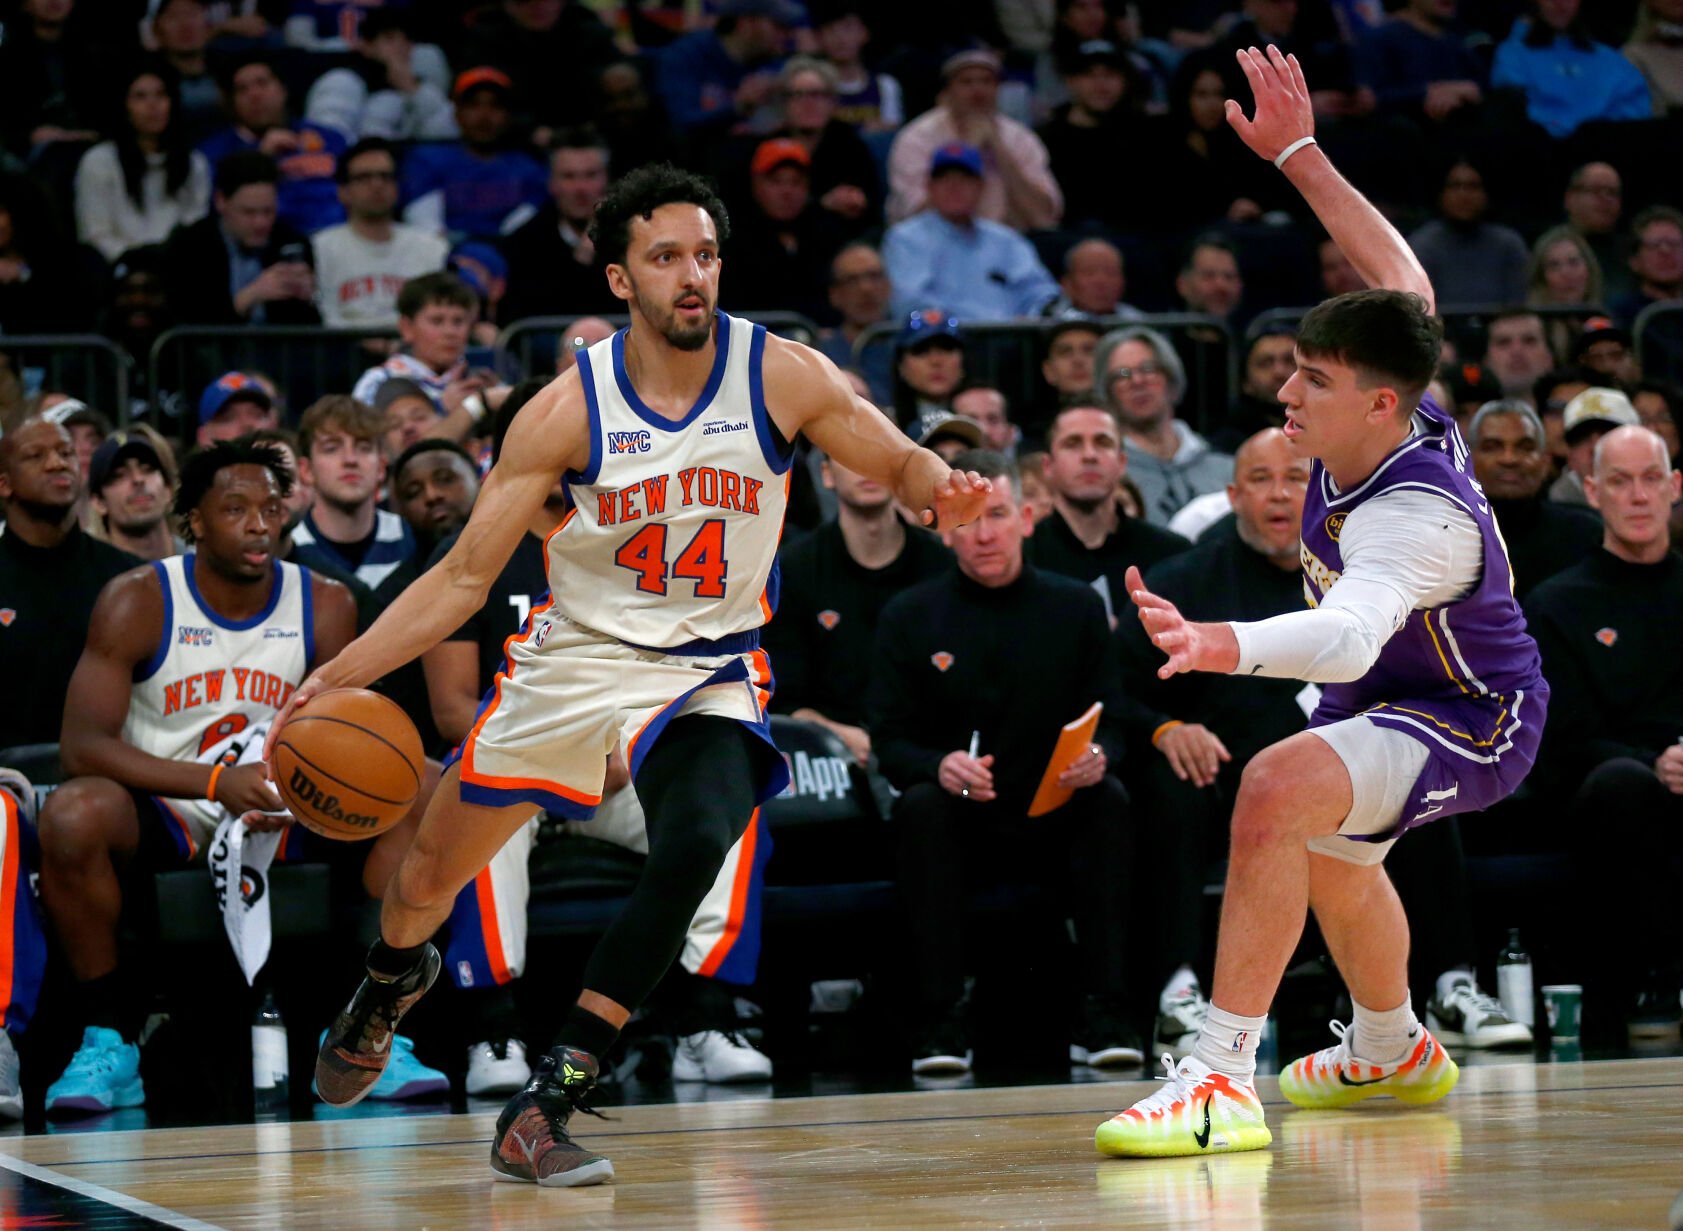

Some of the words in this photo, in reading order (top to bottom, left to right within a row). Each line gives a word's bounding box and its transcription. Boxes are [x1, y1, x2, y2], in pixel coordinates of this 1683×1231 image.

[608, 430, 651, 454] NYC
[703, 426, 720, 436] abu
[721, 421, 749, 433] dhabi
[597, 474, 670, 527] NEW
[678, 466, 764, 516] YORK
[614, 518, 729, 600] 44
[163, 668, 226, 717] NEW
[290, 765, 379, 828] Wilson
[794, 748, 853, 802] App
